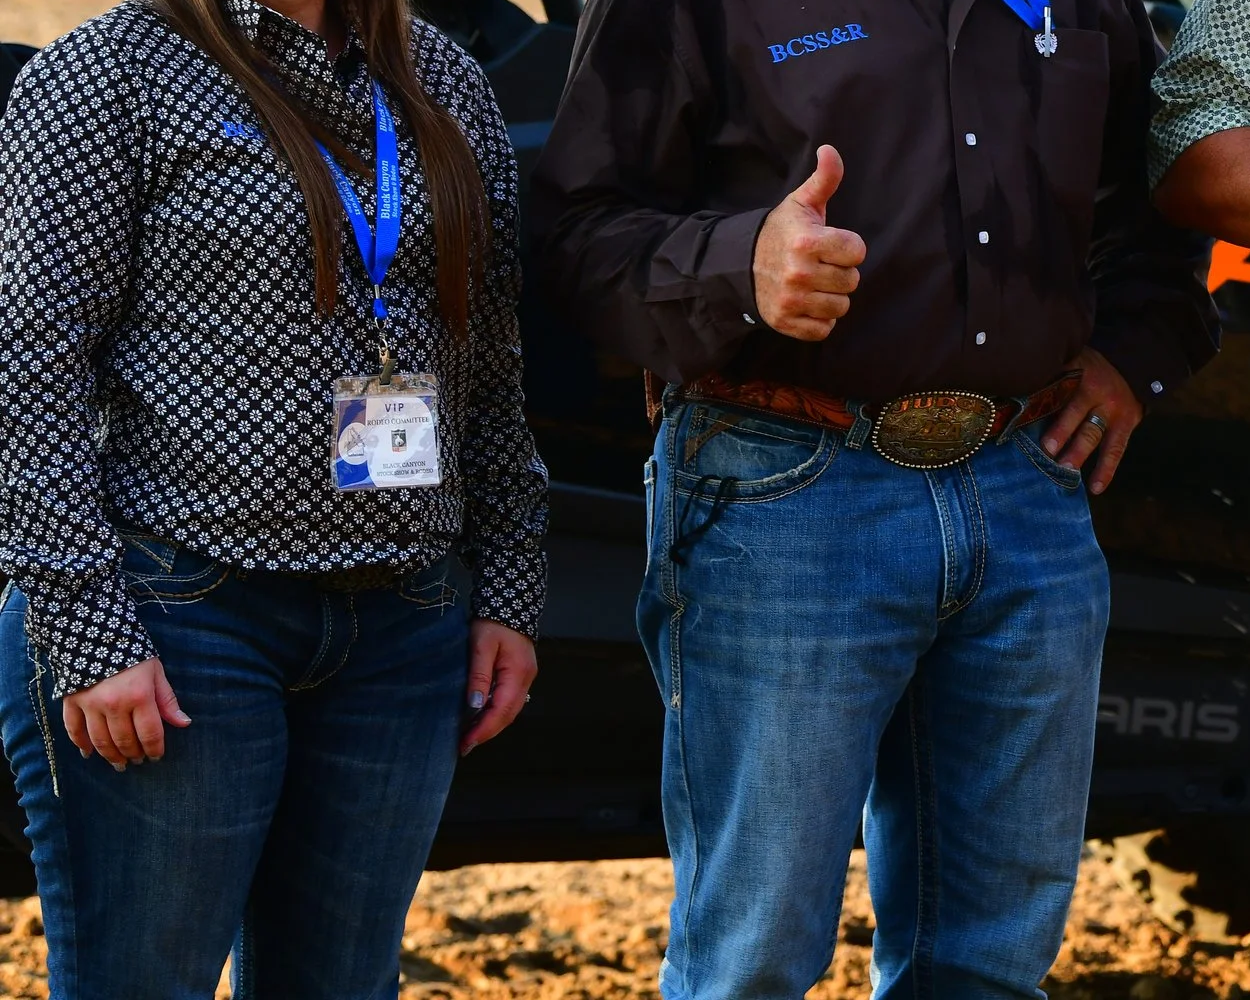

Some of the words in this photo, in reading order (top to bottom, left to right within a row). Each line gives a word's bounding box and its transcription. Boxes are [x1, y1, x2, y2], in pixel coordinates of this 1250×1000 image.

[767, 22, 868, 63] BCSS&R
[381, 160, 391, 191] Canyon
[340, 181, 360, 215] Canyon
[380, 194, 390, 219] Black
[384, 403, 405, 413] VIP
[891, 397, 985, 415] JUDGE
[367, 418, 391, 426] RODEO
[390, 416, 430, 425] COMMITTEE
[401, 460, 426, 468] CANYON
[1097, 693, 1240, 743] ARIS
